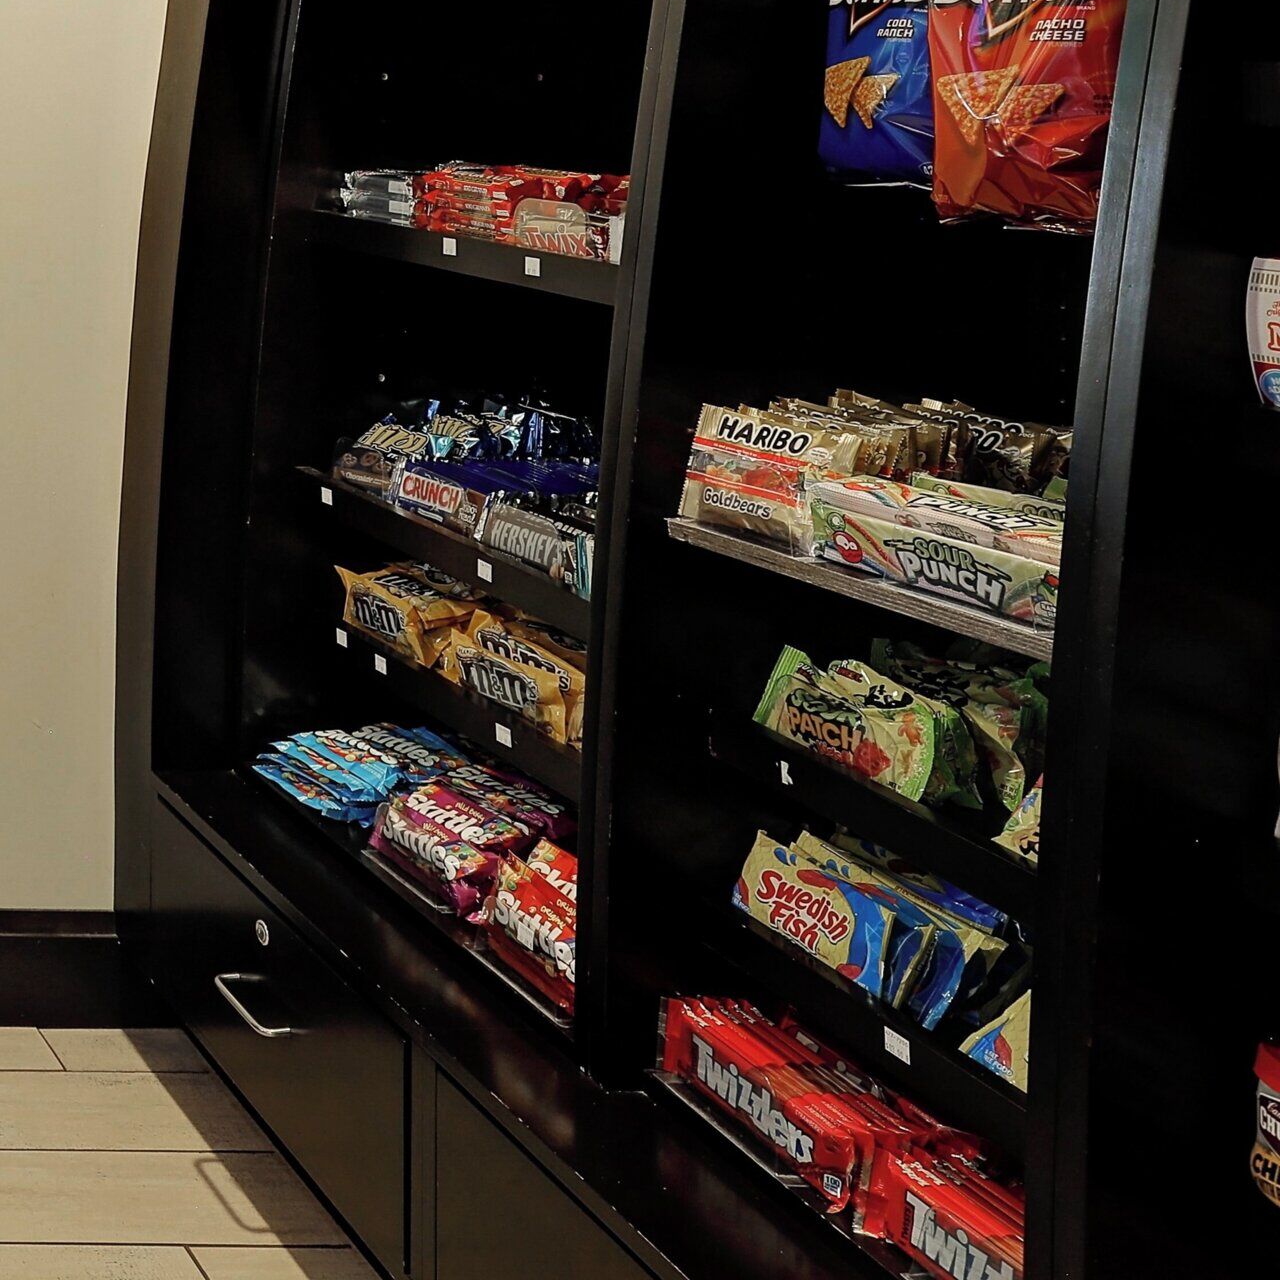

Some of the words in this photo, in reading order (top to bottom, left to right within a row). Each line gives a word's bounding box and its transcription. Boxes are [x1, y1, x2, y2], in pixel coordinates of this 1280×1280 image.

[876, 28, 914, 39] RANCH
[886, 18, 914, 28] COOL
[1028, 30, 1085, 42] CHEESE
[1034, 18, 1085, 30] NACHO
[717, 414, 812, 456] HARIBO
[401, 473, 461, 512] CRUNCH
[704, 486, 772, 519] Goldbears
[491, 520, 565, 568] HERSHEY'S
[913, 537, 975, 571] SOUR
[895, 549, 1006, 612] PUNCH
[351, 724, 440, 770] Skittles
[788, 706, 863, 751] PATCH
[404, 793, 496, 847] Skittles
[383, 811, 462, 881] Skittles
[755, 869, 850, 943] Swedish
[769, 900, 820, 955] Fish
[692, 1032, 815, 1165] Twizzlers
[825, 1174, 841, 1187] 100
